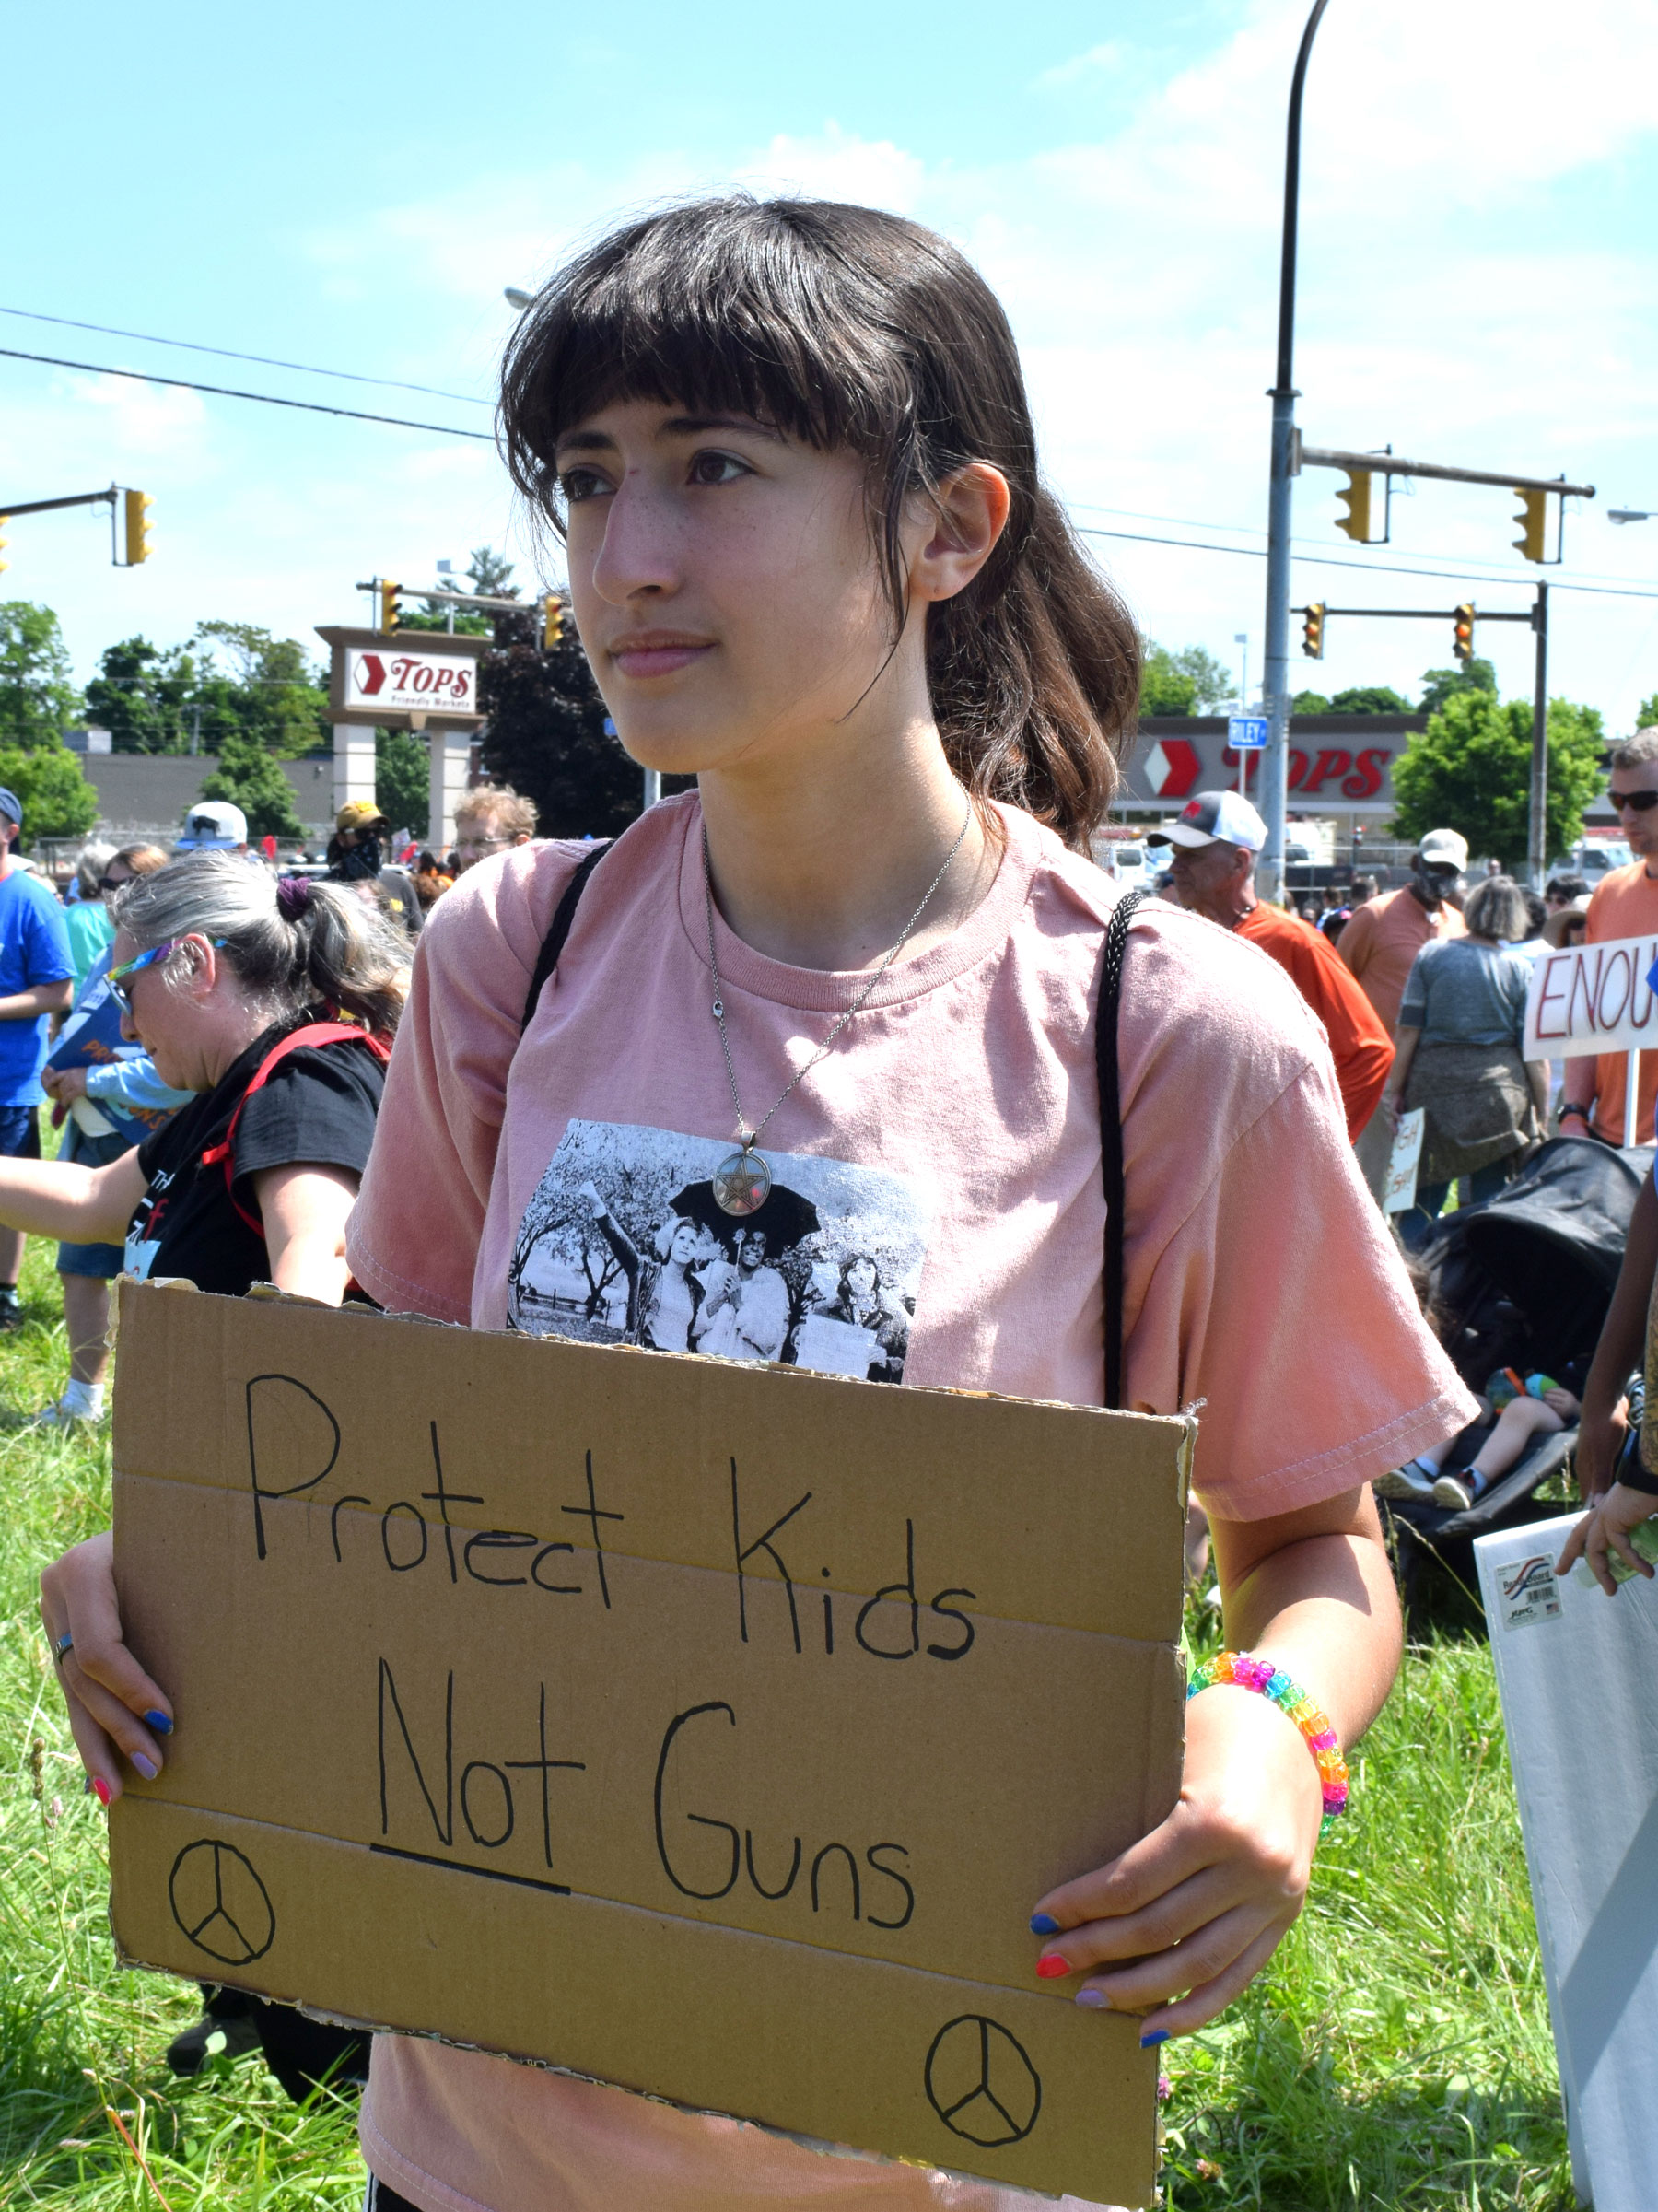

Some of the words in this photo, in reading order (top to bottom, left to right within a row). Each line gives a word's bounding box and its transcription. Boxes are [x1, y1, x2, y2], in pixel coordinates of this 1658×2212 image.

[391, 657, 473, 698] TOPS
[1535, 942, 1658, 1040] ENOU
[246, 1374, 624, 1609] Protect
[730, 1456, 976, 1661] Kids
[378, 1656, 587, 1869] Not
[653, 1701, 916, 1930] Guns
